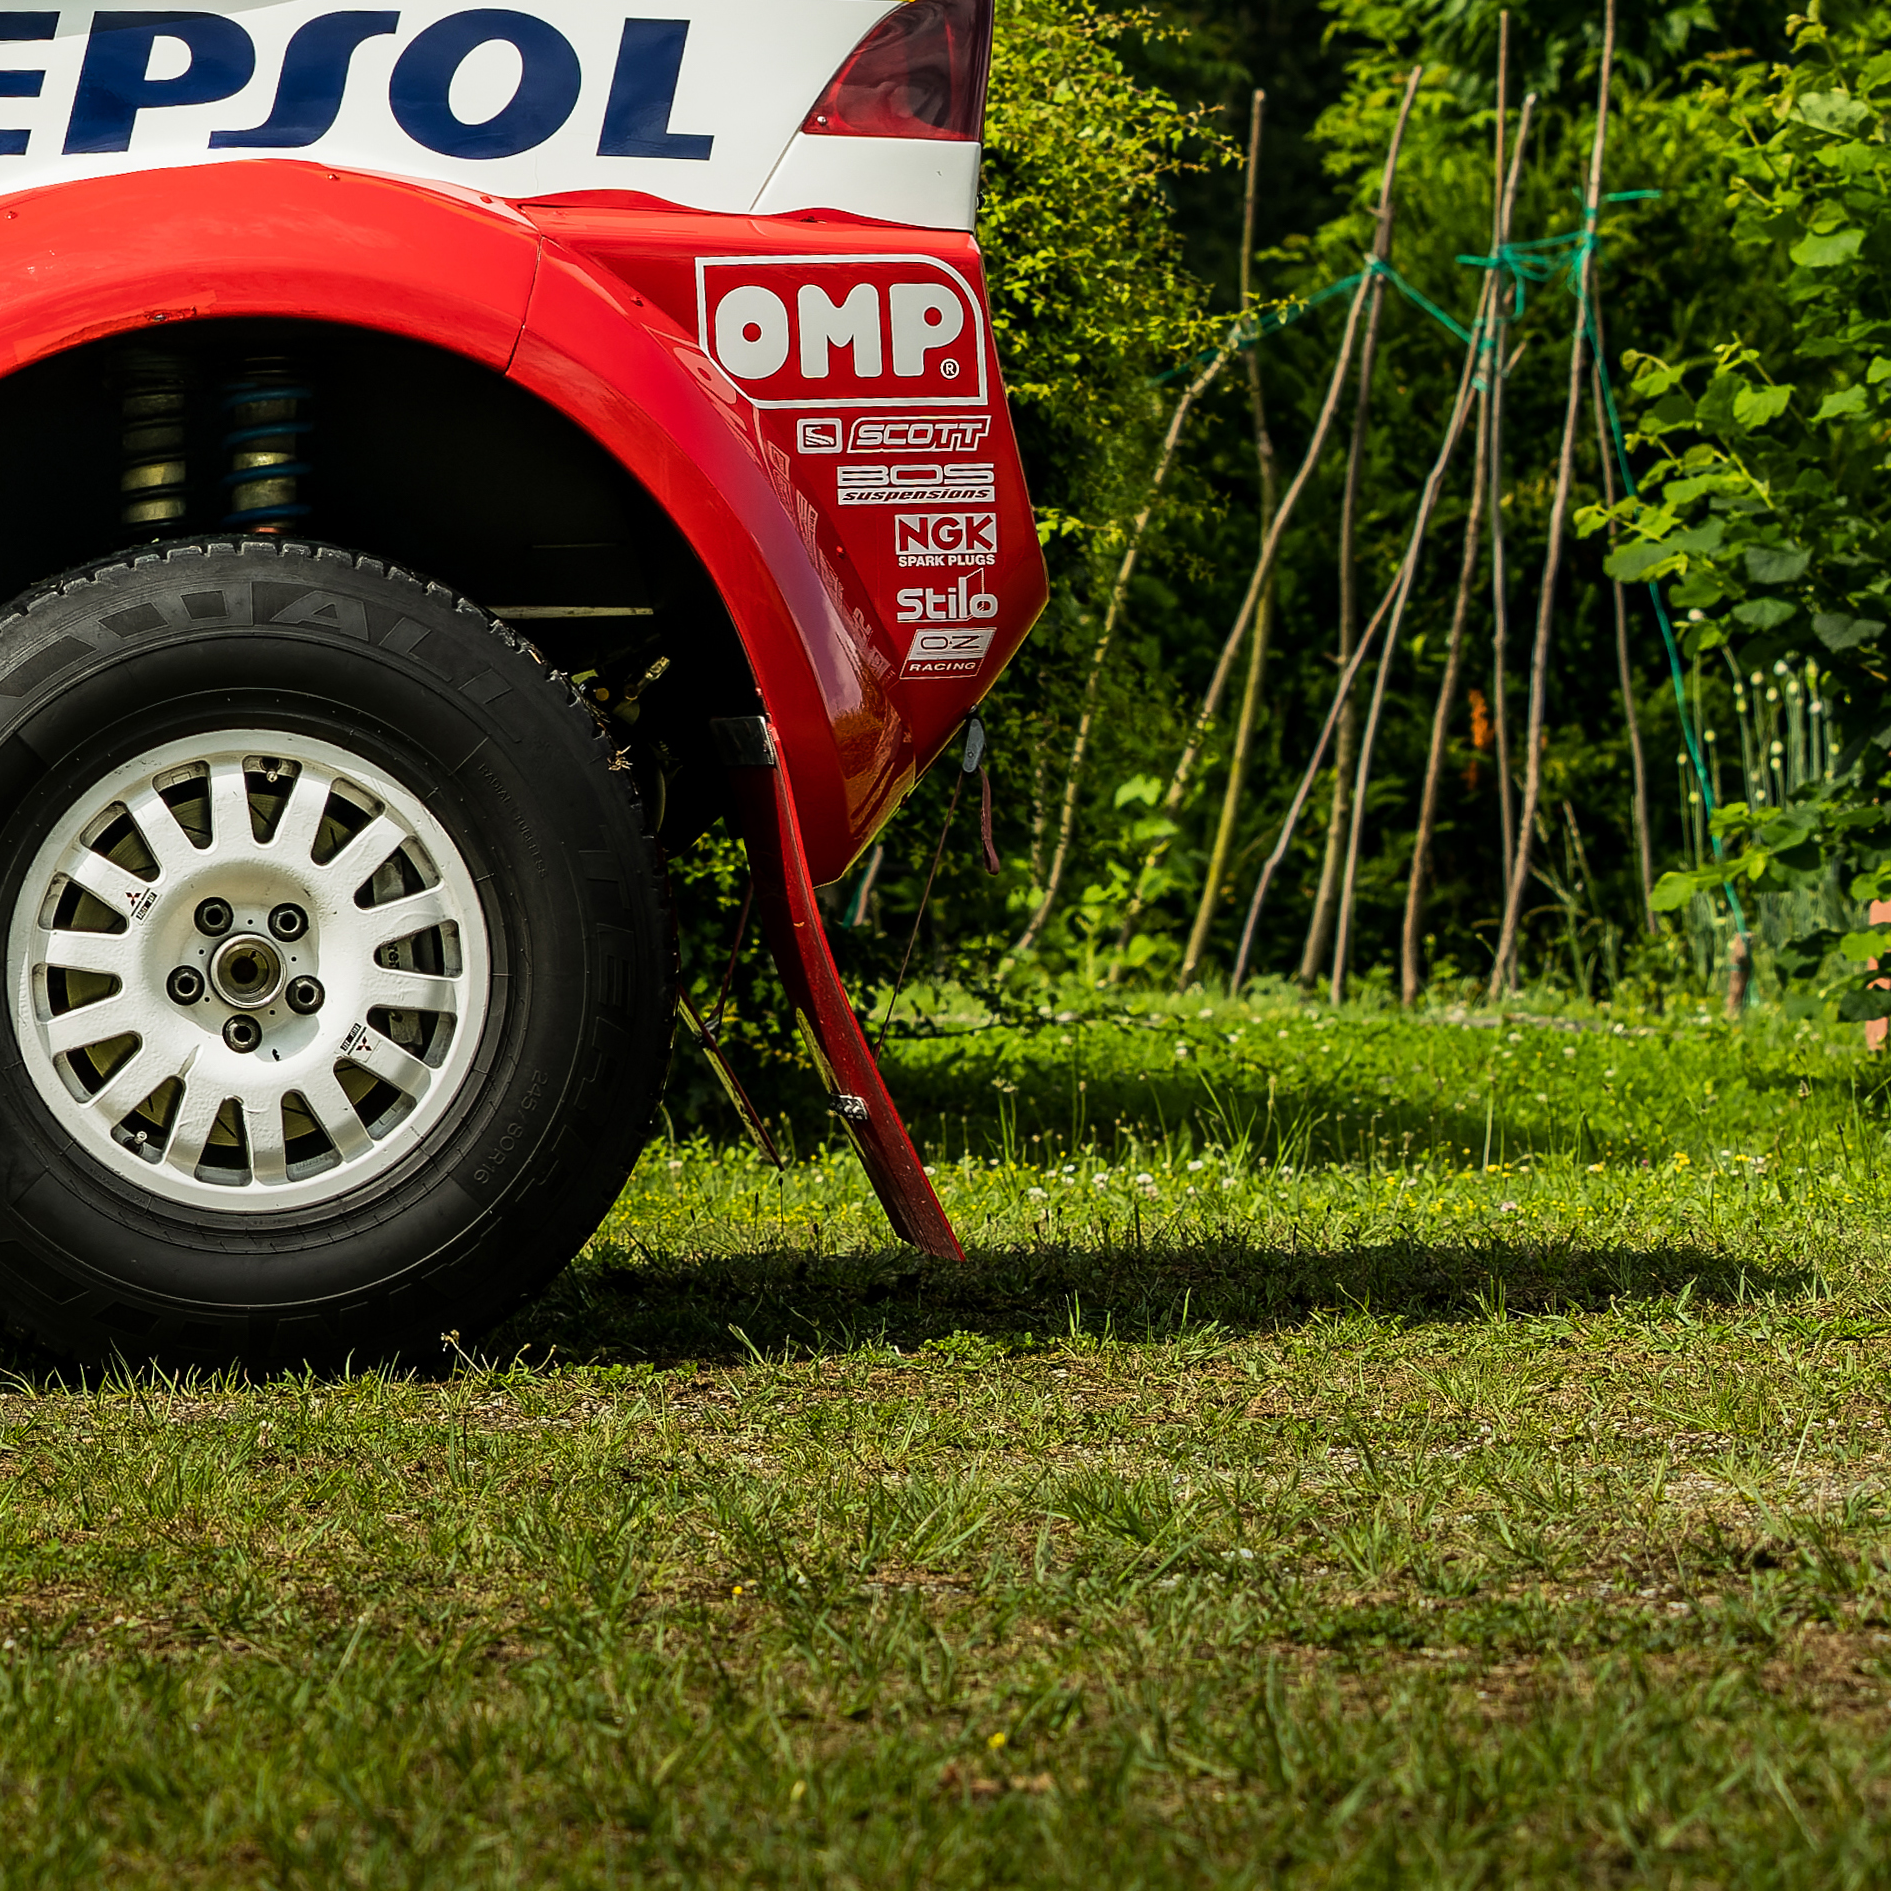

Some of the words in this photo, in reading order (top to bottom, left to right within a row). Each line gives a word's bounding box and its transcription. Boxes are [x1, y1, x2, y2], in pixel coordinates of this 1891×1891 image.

[714, 282, 965, 380] OMP
[855, 422, 983, 446] SCOTT
[836, 463, 995, 487] BOS
[841, 488, 991, 502] suspensions
[898, 514, 994, 552] NGK
[898, 554, 946, 567] SPARK
[948, 553, 996, 567] PLUGS
[896, 576, 999, 621] Stilo
[272, 587, 524, 744] ALL
[909, 662, 977, 673] RACING
[468, 1068, 551, 1188] 245/80R16
